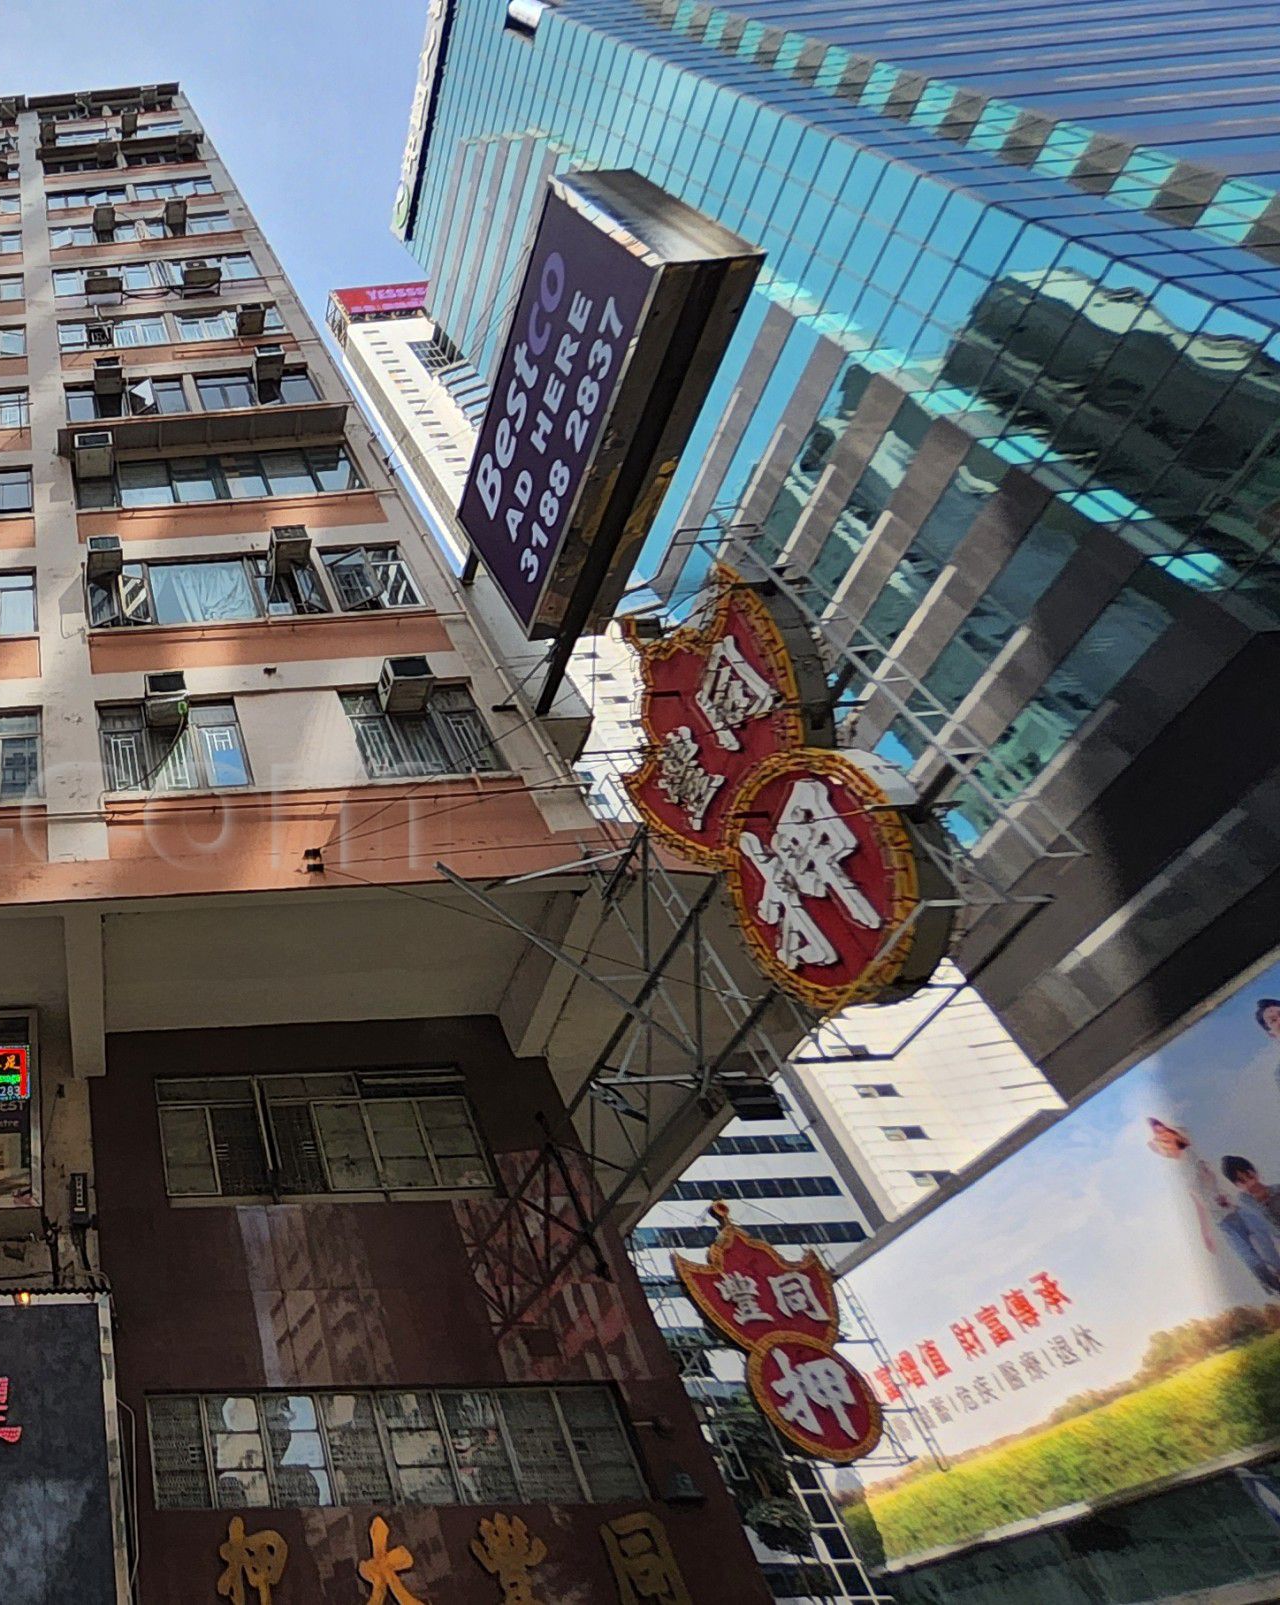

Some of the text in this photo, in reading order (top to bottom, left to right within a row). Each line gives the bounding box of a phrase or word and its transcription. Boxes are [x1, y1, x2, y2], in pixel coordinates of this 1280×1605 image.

[506, 290, 594, 544] AD HERE
[520, 296, 624, 583] 3188 2837
[739, 778, 881, 971] 押
[771, 1347, 860, 1441] 押
[863, 1338, 952, 1404] 富增值
